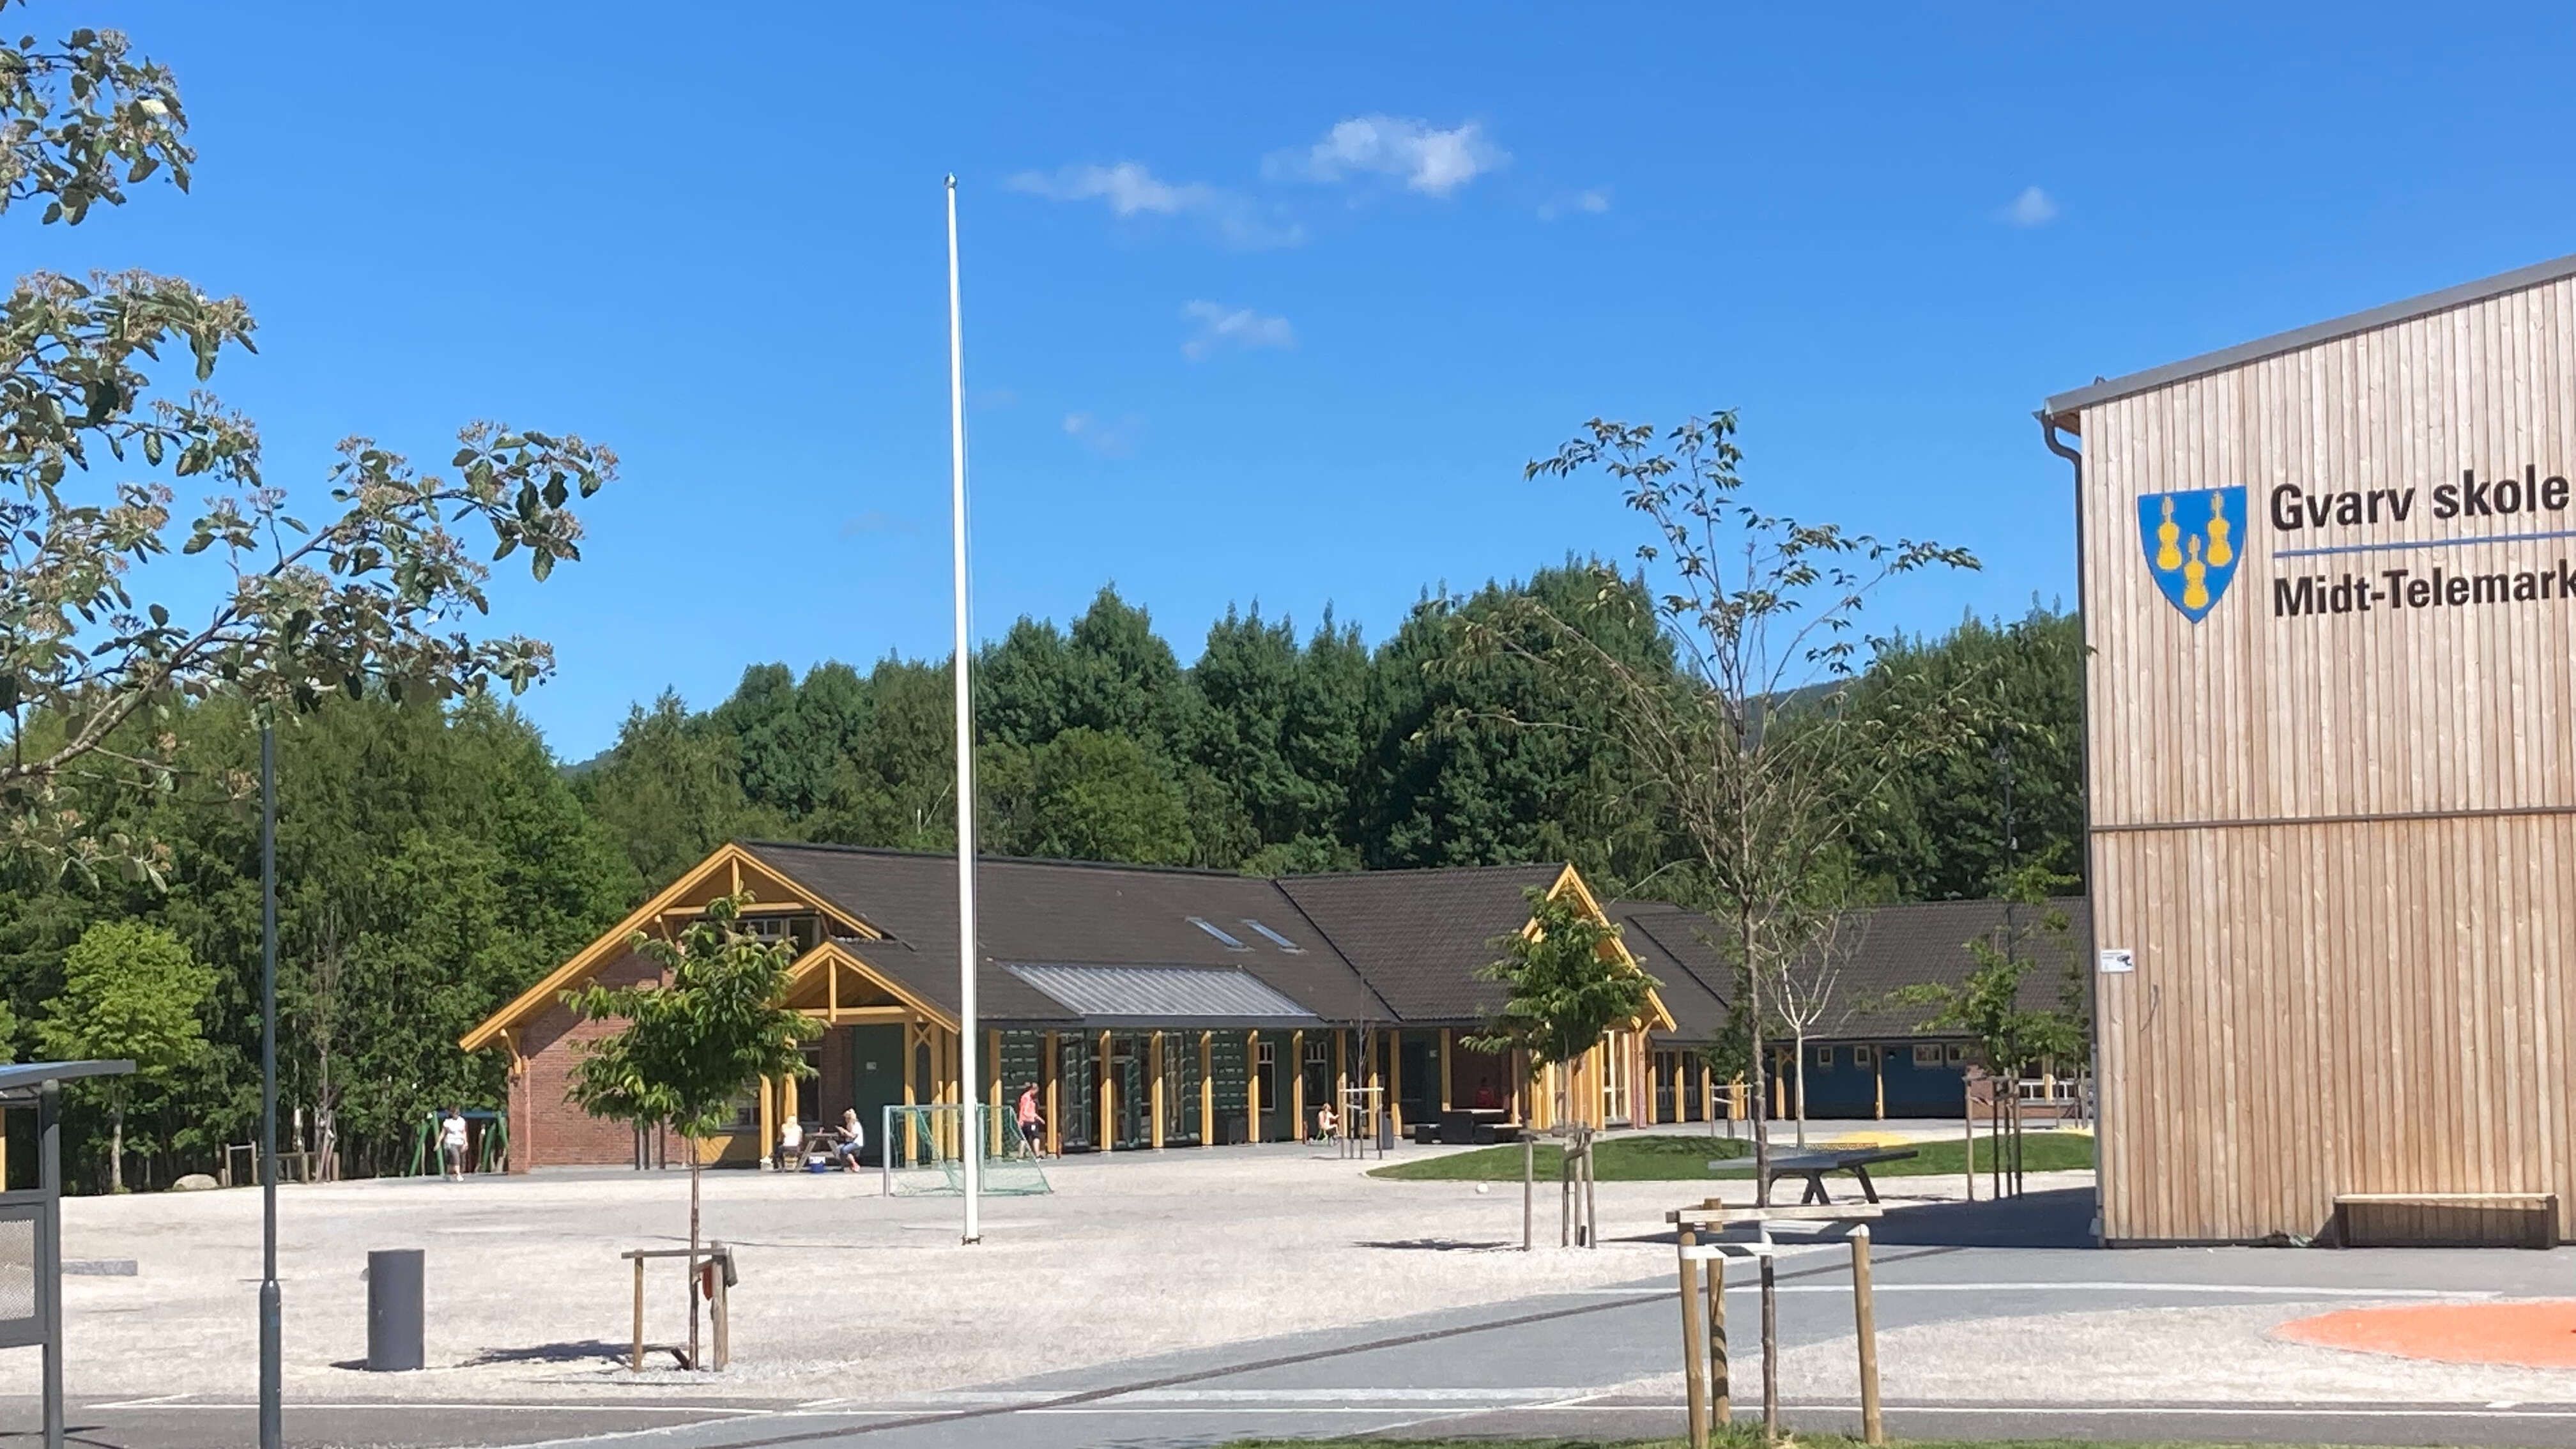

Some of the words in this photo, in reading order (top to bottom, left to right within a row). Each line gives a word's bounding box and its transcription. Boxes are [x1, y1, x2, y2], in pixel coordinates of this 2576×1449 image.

[2270, 482, 2416, 532] Gvarv
[2433, 464, 2570, 519] skole
[2273, 558, 2576, 617] Midt-Telemark
